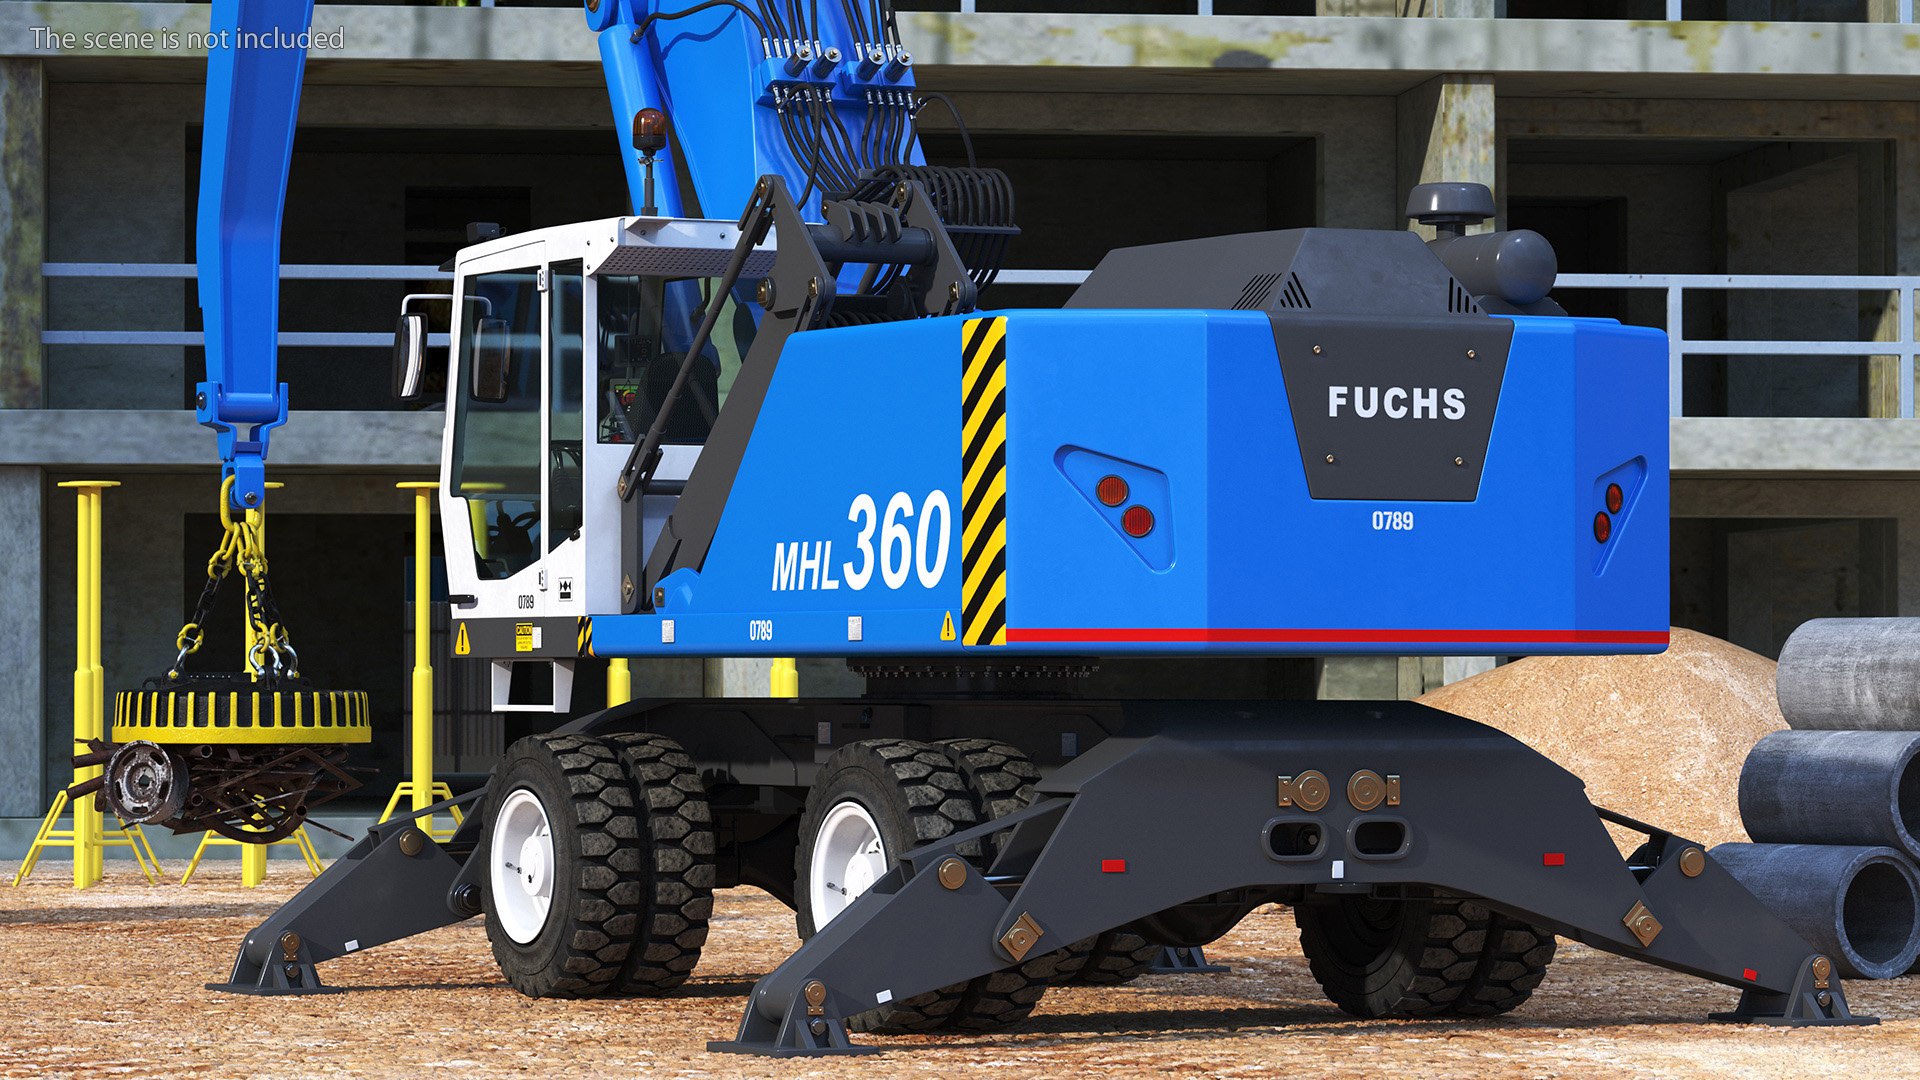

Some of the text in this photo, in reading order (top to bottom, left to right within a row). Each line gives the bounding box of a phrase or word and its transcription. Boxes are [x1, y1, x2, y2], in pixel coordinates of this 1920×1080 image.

[1328, 386, 1466, 420] FUCHS
[1372, 511, 1414, 530] 0789
[771, 489, 951, 591] MHL 360
[518, 595, 534, 609] 0789
[749, 619, 773, 641] 0789
